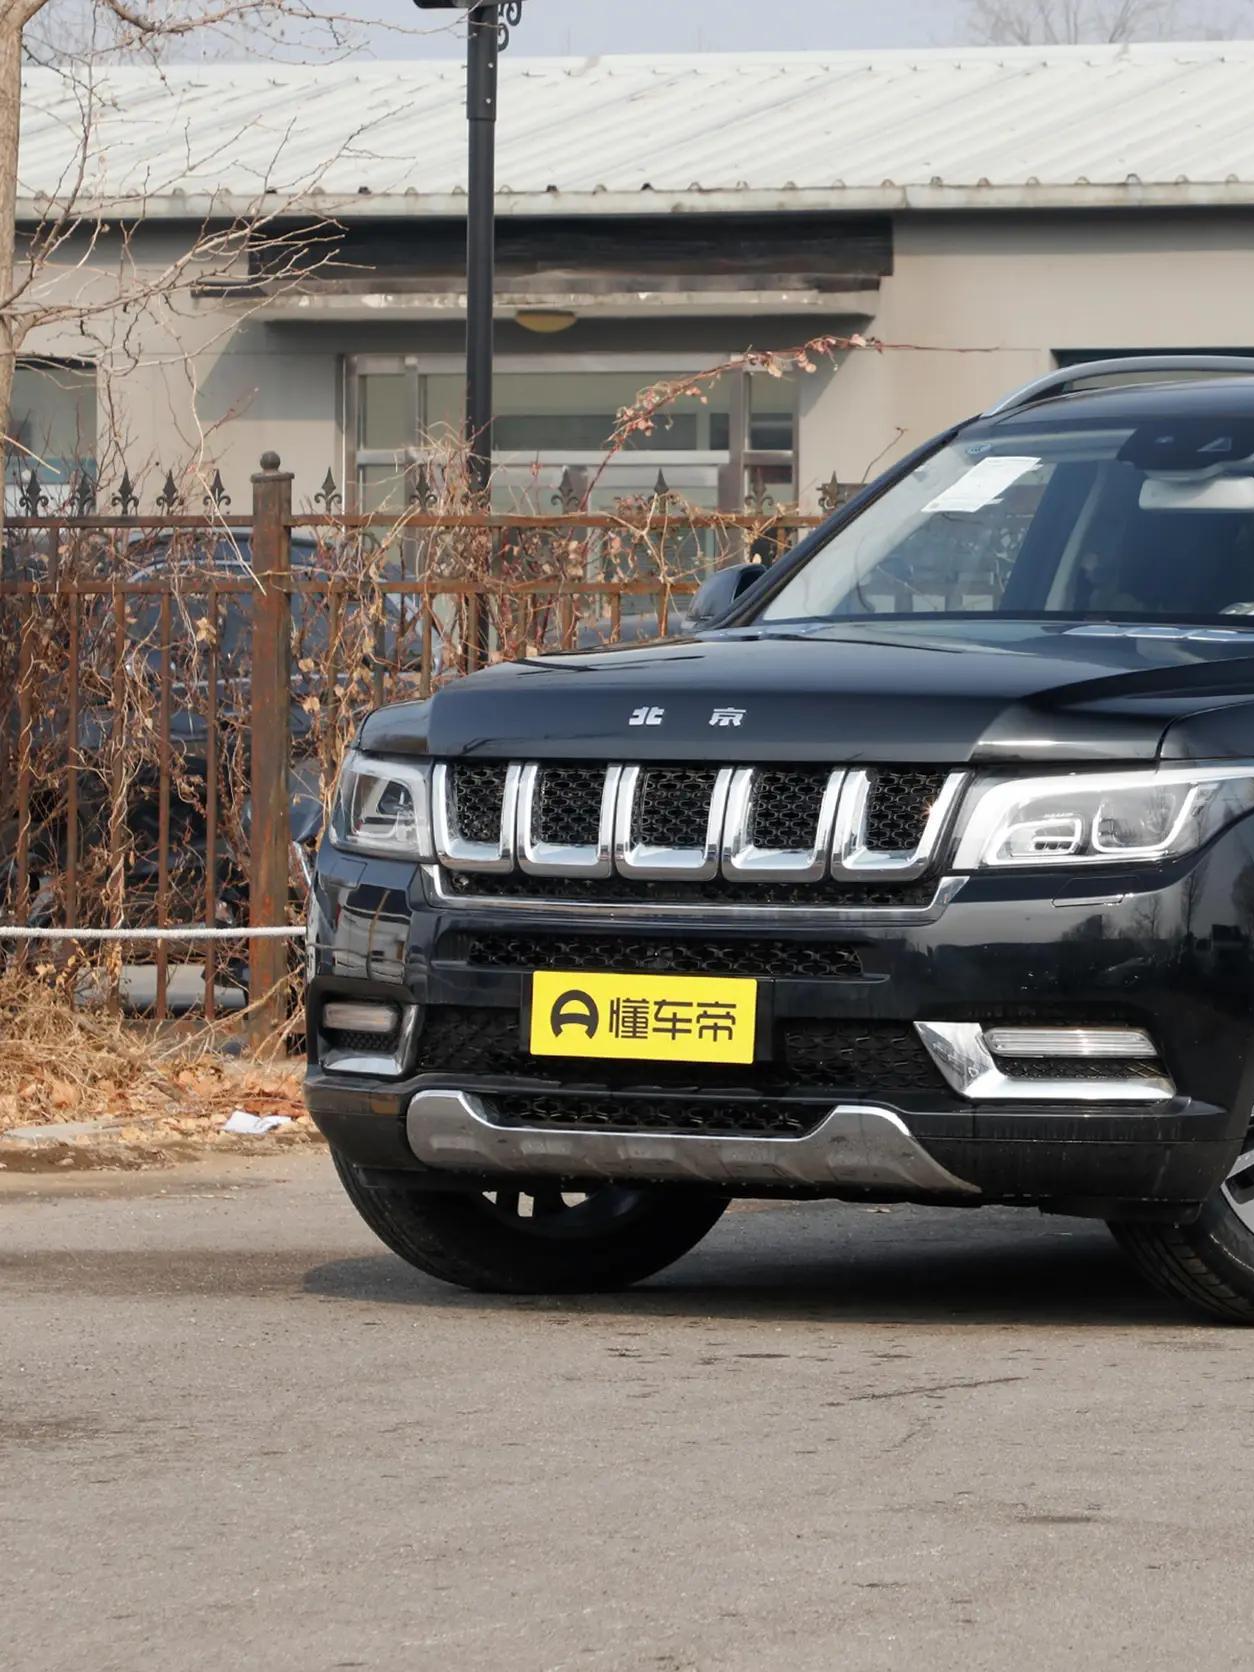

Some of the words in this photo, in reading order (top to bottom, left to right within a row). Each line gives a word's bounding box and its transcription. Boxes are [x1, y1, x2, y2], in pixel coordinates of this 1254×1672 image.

[629, 706, 747, 727] 北京
[609, 997, 737, 1042] 懂车帝
